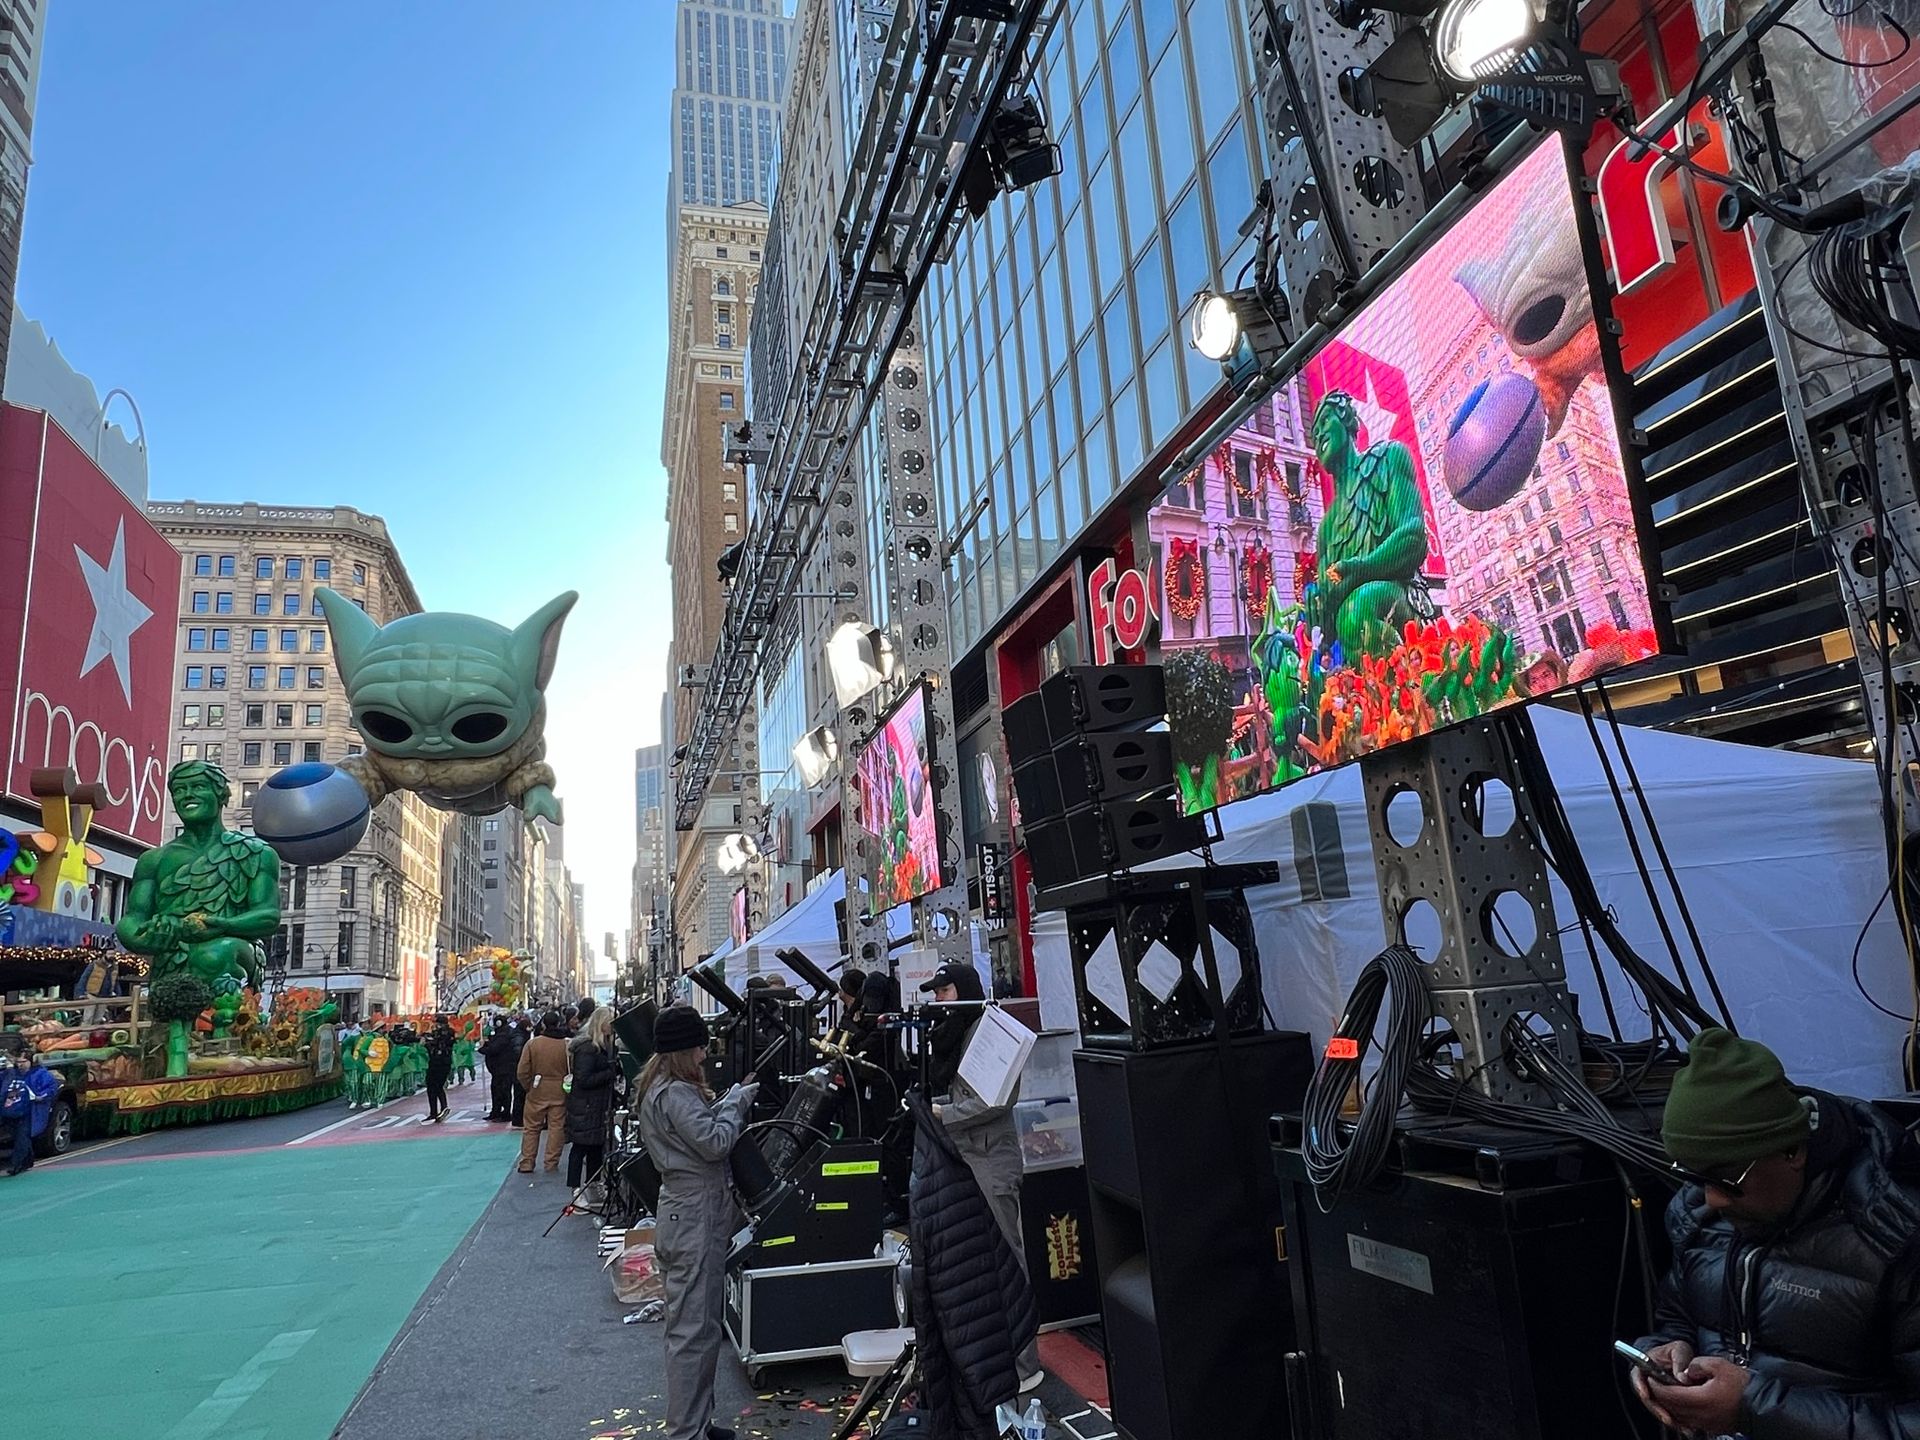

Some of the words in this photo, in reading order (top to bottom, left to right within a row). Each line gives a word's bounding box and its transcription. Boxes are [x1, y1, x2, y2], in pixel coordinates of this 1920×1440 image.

[1534, 73, 1584, 83] WISYCOM
[983, 846, 997, 898] TISSOT
[1771, 1277, 1821, 1299] Marmot
